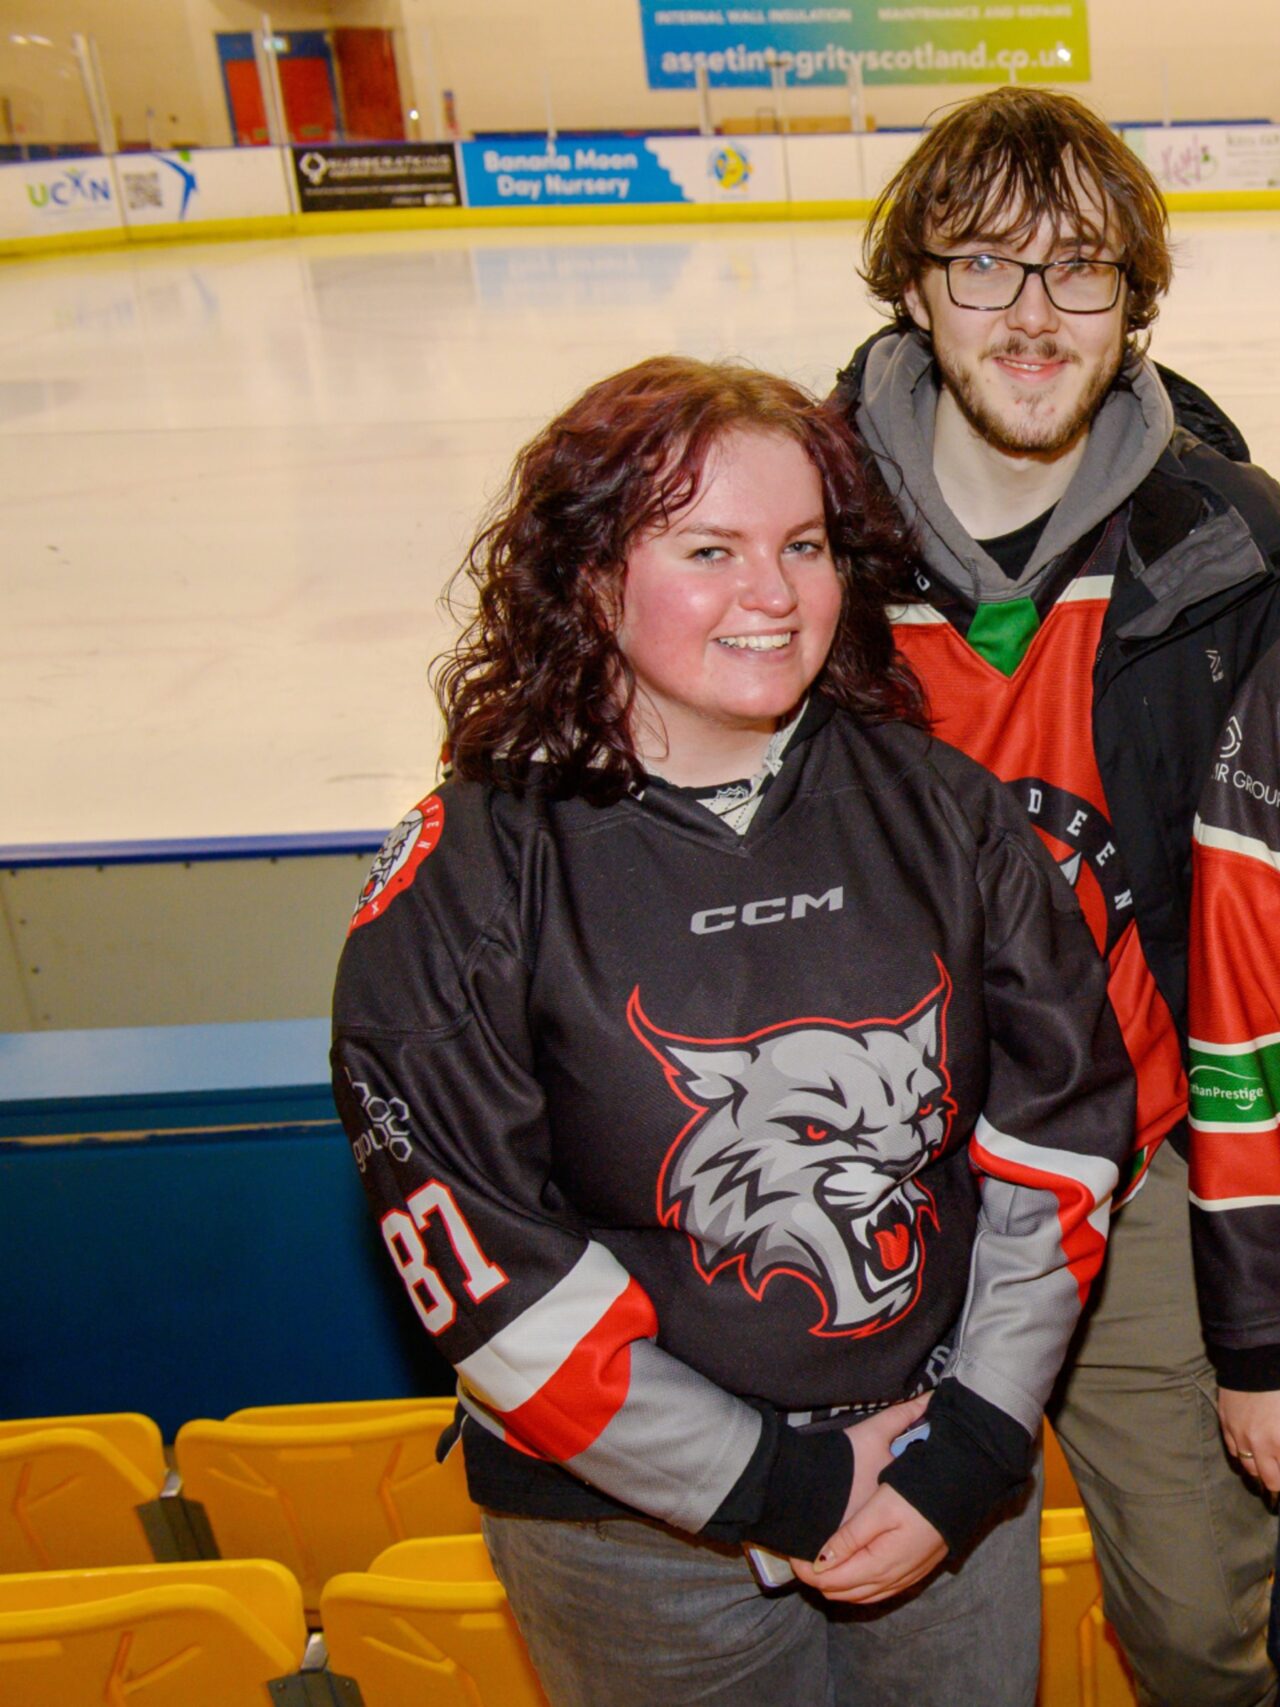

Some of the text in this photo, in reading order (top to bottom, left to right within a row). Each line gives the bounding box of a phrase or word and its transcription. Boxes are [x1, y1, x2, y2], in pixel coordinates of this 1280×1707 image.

[726, 9, 766, 25] WALL
[661, 40, 1073, 79] assetintegrityscotland.co.uk
[483, 148, 638, 173] Banana Moon
[497, 173, 630, 200] Day Nursery
[1027, 788, 1133, 911] DEEN
[690, 886, 844, 935] CCM
[381, 1177, 510, 1337] 87
